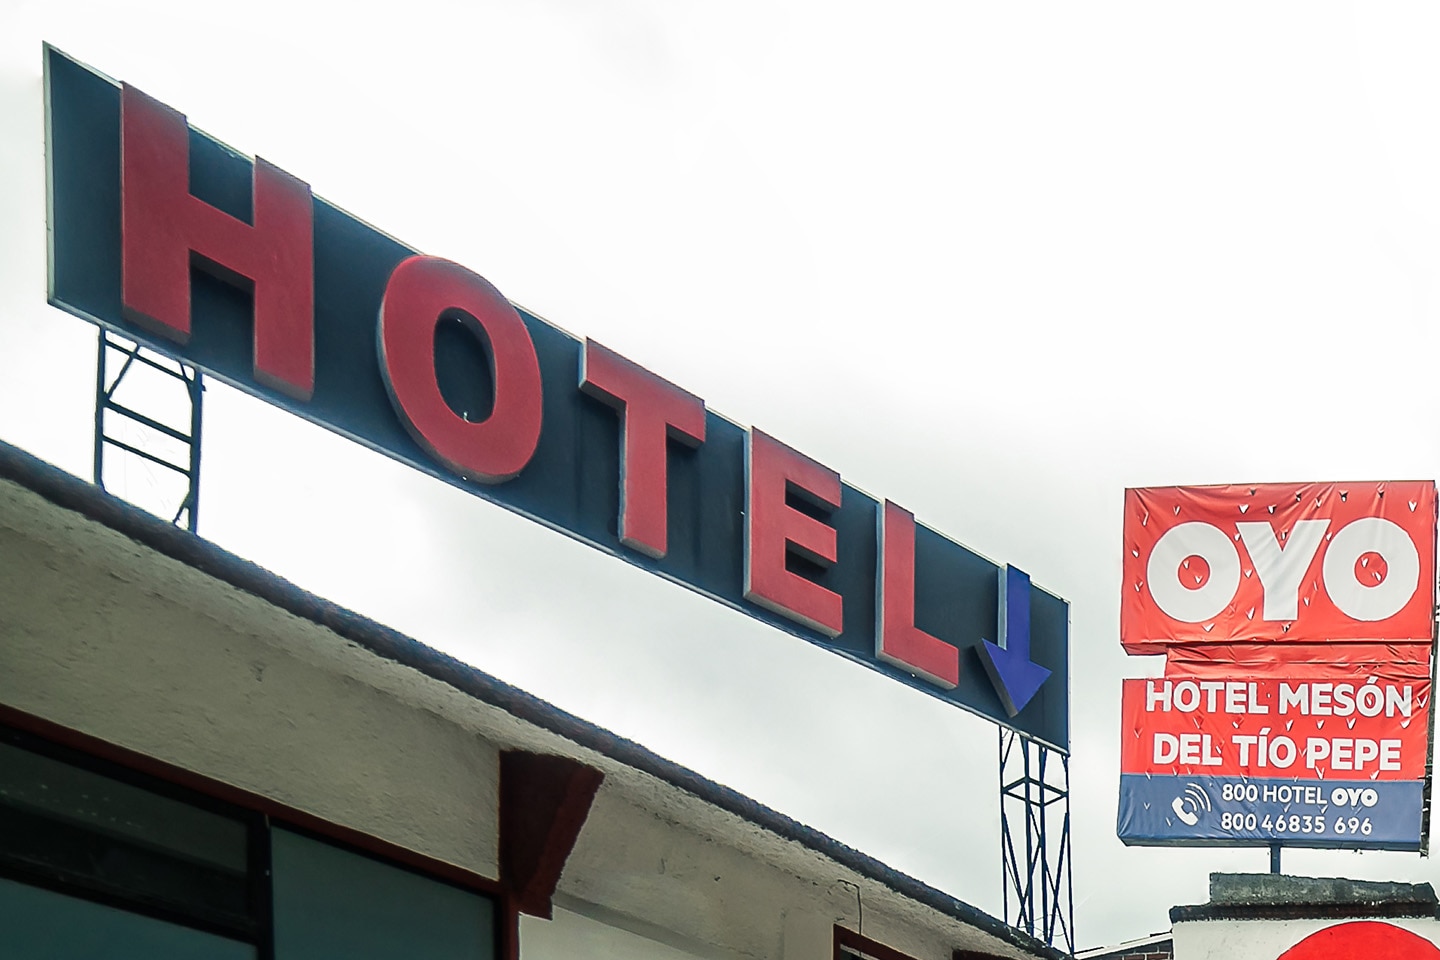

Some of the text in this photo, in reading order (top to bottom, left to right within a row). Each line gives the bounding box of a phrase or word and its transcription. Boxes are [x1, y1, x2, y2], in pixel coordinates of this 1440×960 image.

[121, 81, 959, 691] HOTEL
[1146, 517, 1421, 622] OYO
[1145, 676, 1413, 718] HOTEL MESÓN
[1153, 728, 1402, 771] DEL TÍO PEPE
[1222, 784, 1378, 807] 800 HOTEL OYO
[1221, 812, 1372, 835] 800 46835 696
